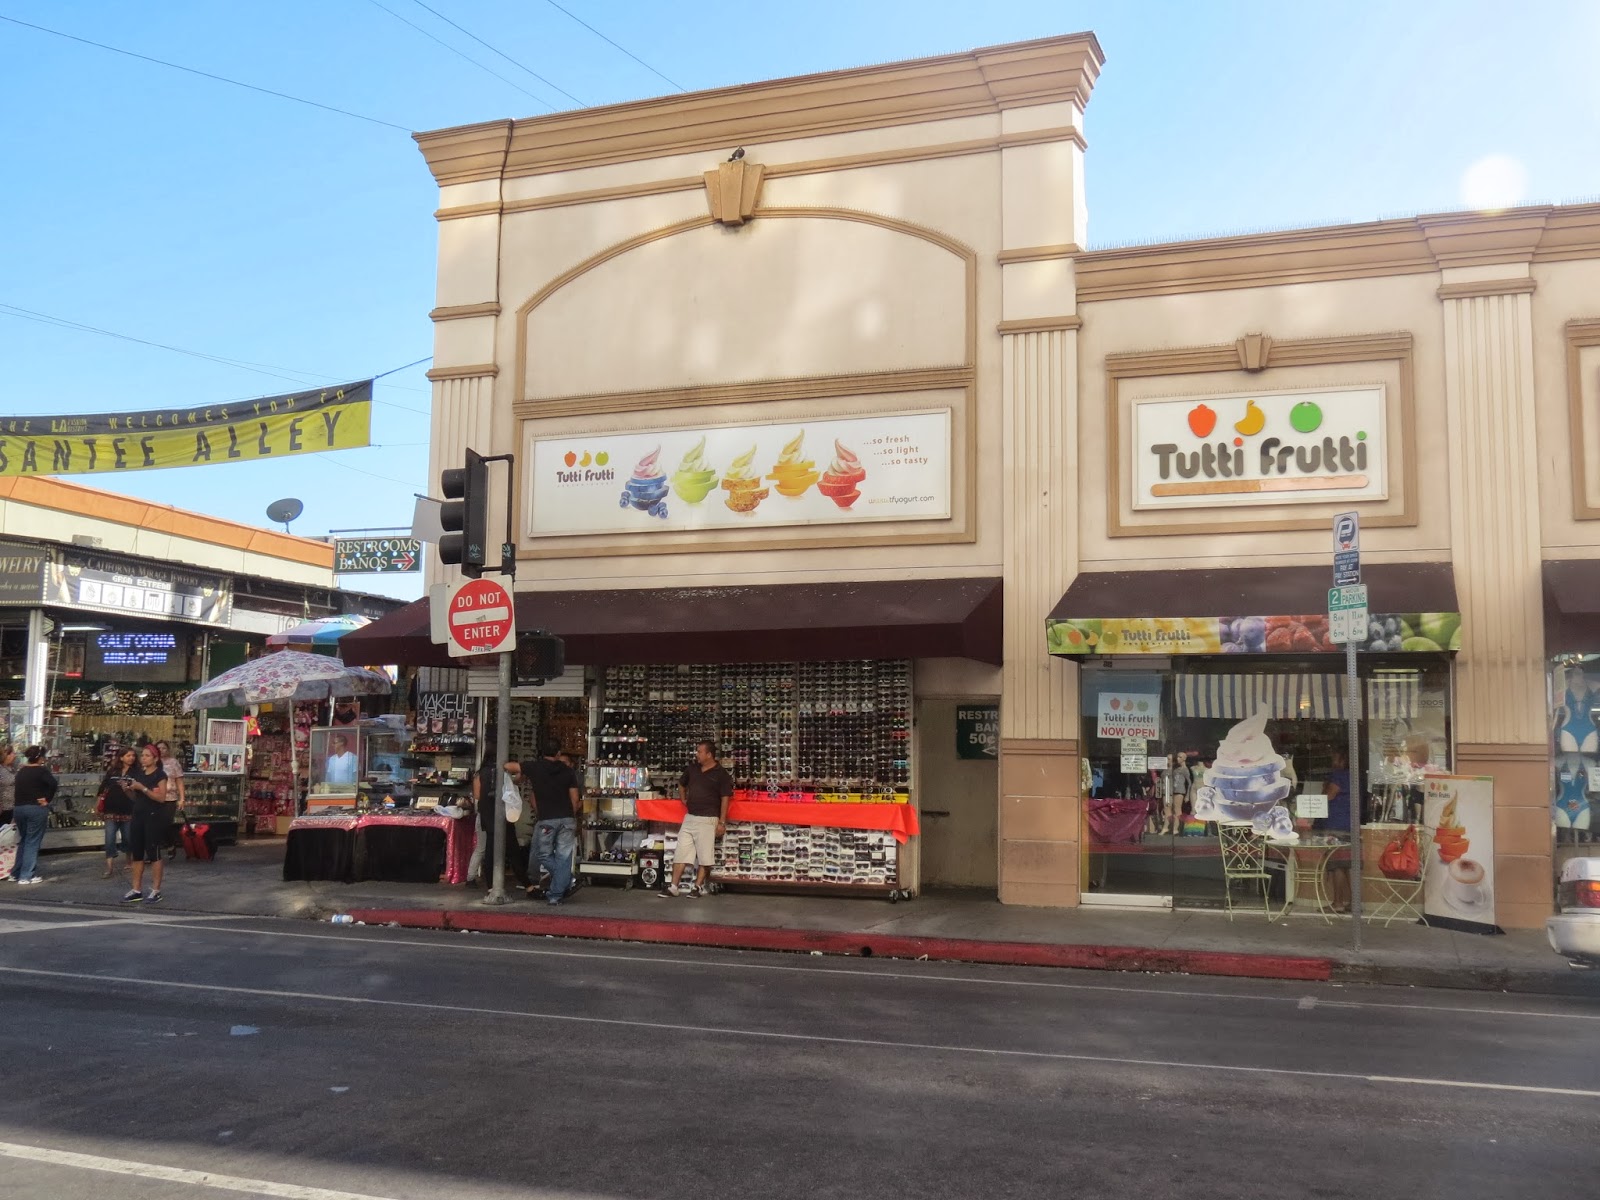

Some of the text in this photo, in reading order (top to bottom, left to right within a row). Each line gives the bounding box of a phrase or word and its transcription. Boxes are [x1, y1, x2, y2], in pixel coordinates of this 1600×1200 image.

[109, 389, 345, 429] WELCOMES YOU TO
[0, 420, 67, 432] HE LA
[0, 411, 342, 472] SANTEE ALLEY
[886, 435, 910, 443] fresh
[896, 446, 919, 455] light
[904, 457, 928, 465] tasty
[1150, 437, 1244, 479] Tutti
[556, 470, 582, 483] Tutti
[336, 538, 420, 554] RESTROOMS
[339, 554, 388, 570] BAÑOS
[458, 592, 501, 608] DO NOT
[1332, 591, 1339, 604] 2
[1342, 592, 1366, 604] PARKING
[464, 625, 500, 640] ENTER
[1121, 628, 1152, 641] Tutti
[418, 710, 469, 719] COSMETICS
[1103, 713, 1125, 722] Tutti
[1101, 727, 1155, 737] NOW OPEN
[969, 733, 995, 745] 50¢
